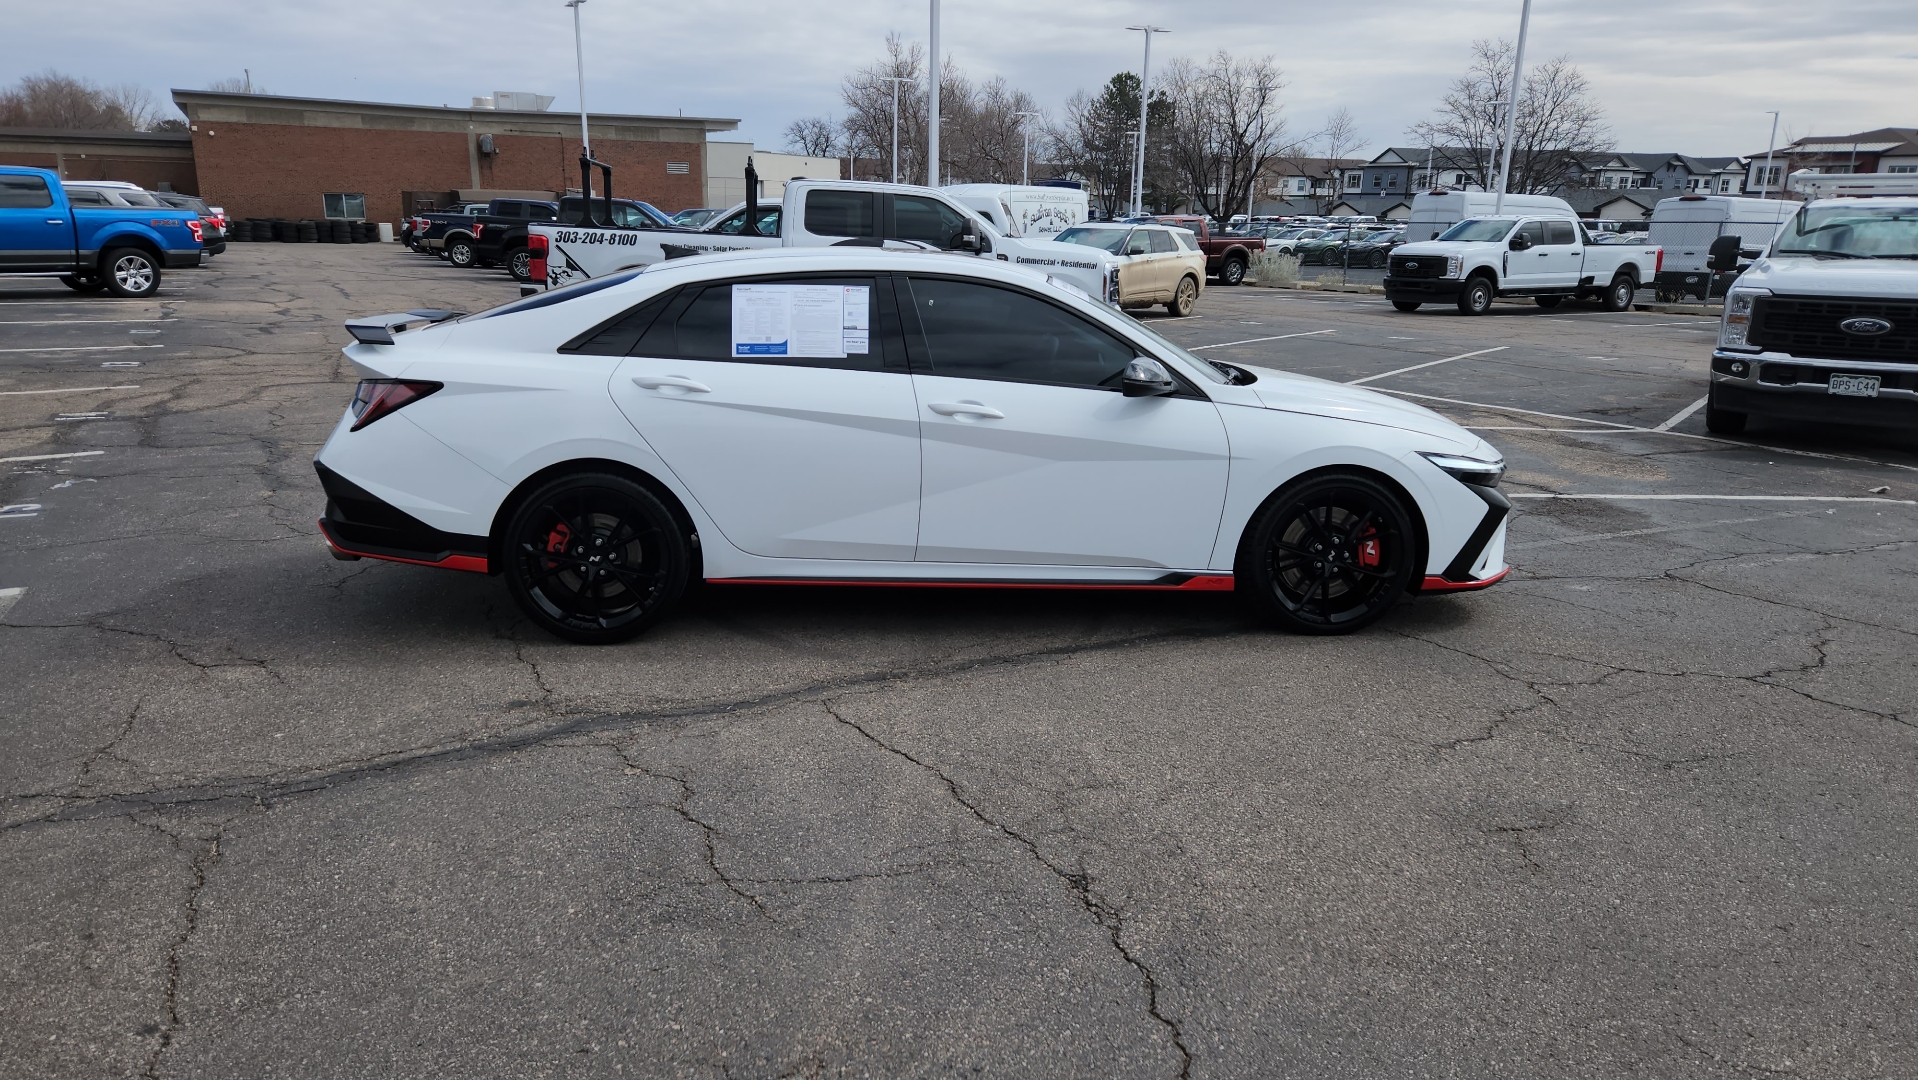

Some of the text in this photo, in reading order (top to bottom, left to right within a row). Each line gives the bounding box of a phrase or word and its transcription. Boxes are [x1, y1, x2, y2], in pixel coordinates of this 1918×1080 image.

[554, 230, 638, 246] 303-204-8100
[1016, 255, 1098, 270] Commercial Residential
